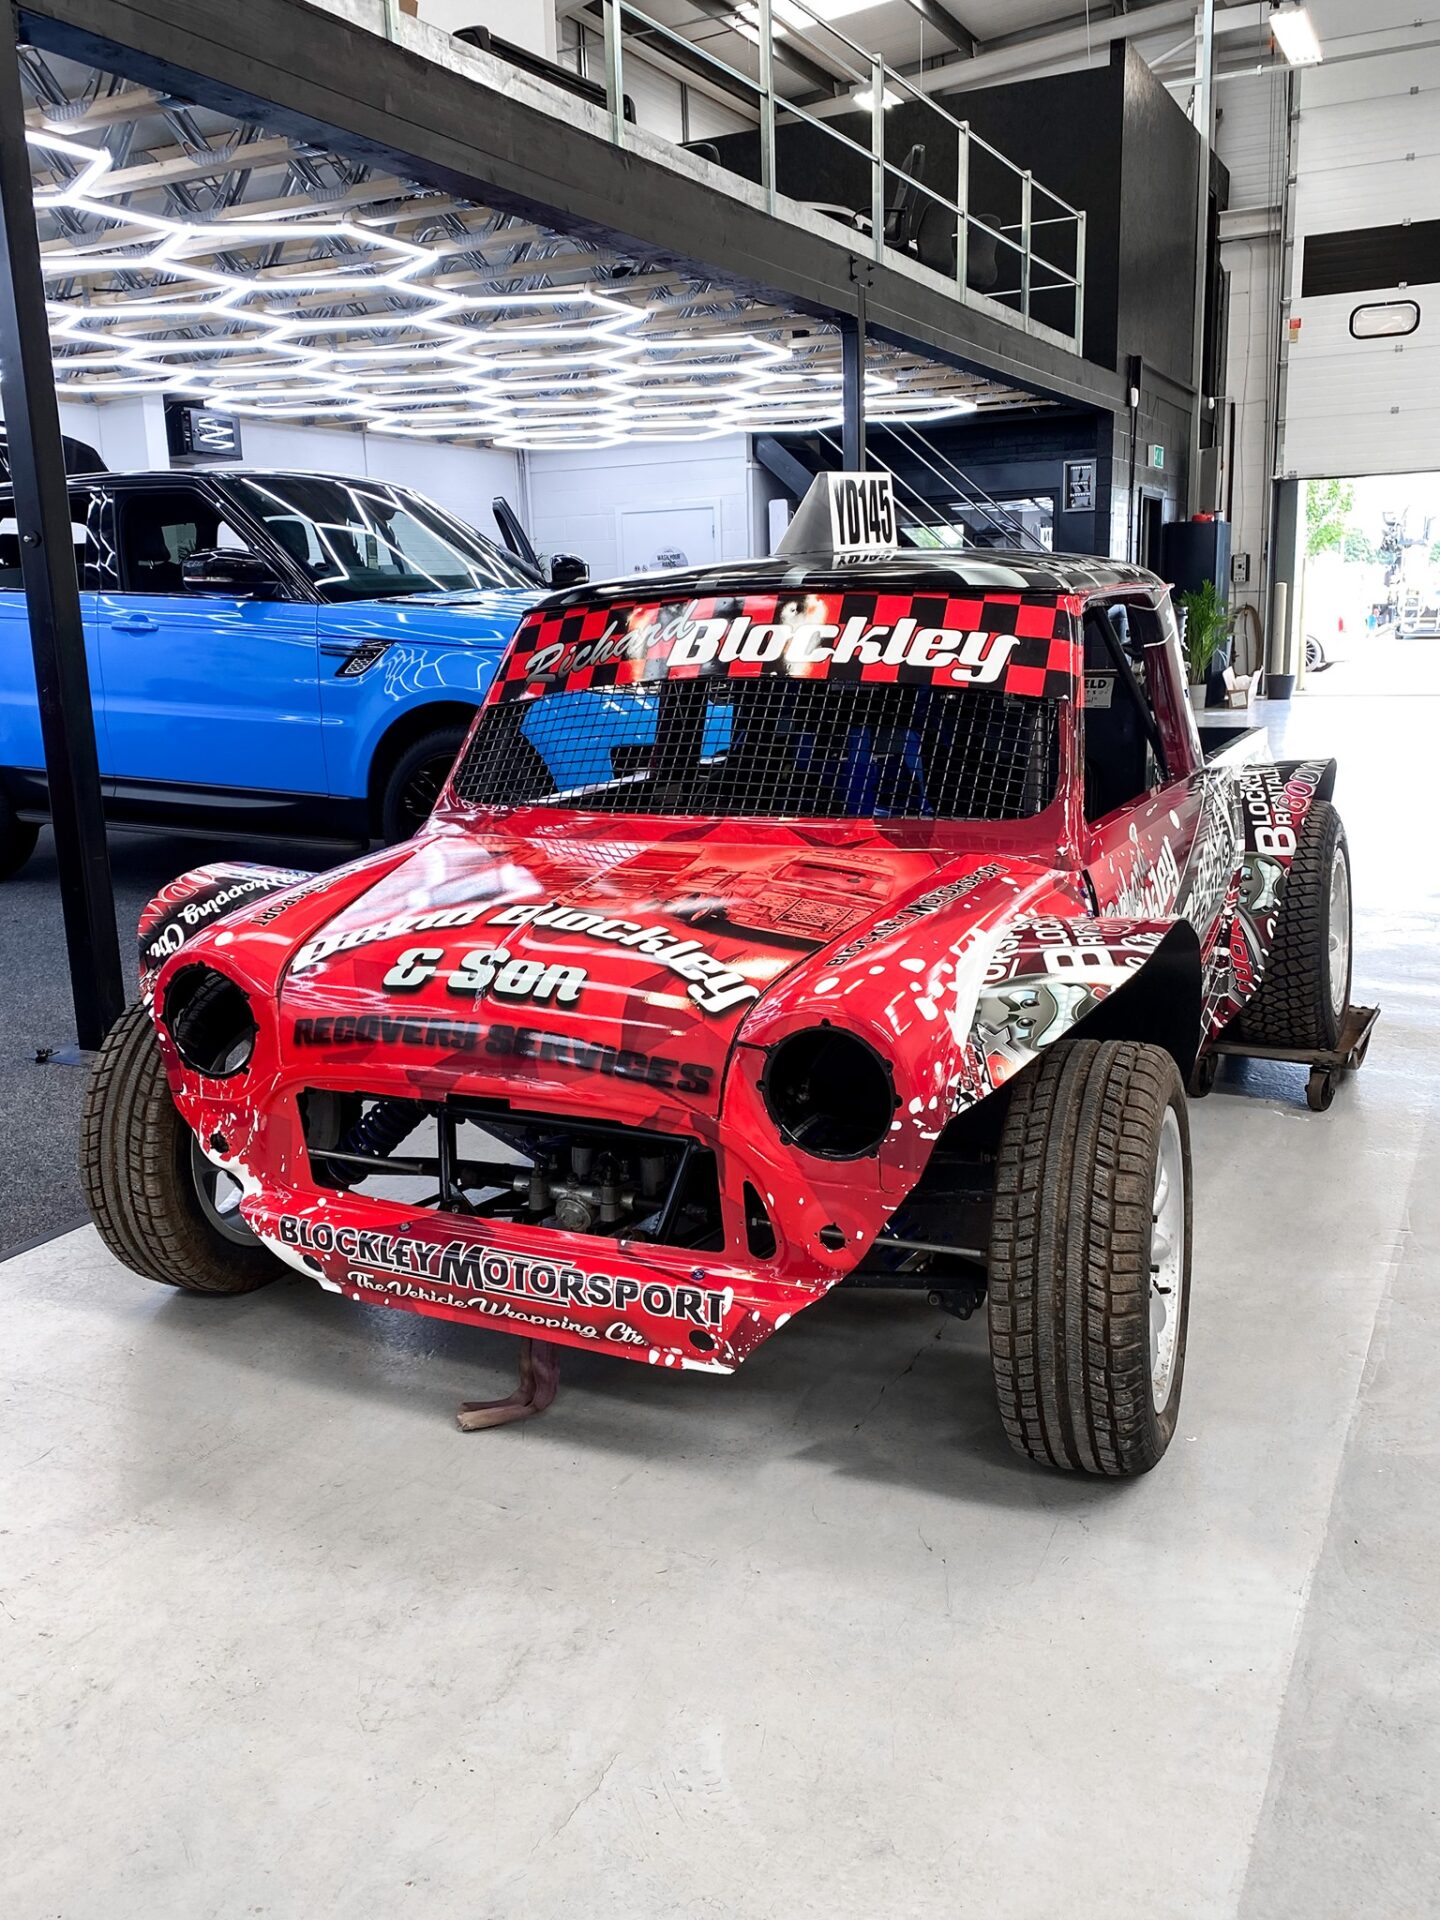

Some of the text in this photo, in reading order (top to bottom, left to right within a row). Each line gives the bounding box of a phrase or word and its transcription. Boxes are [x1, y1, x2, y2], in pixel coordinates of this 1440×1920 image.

[833, 479, 893, 545] YD145
[526, 599, 1021, 684] Richard Blockley
[823, 862, 1011, 968] BLOCKLEY MOTORSPORT
[383, 946, 588, 1005] & Son
[486, 903, 760, 1013] Blockley
[292, 1014, 715, 1095] RECOVERY SERVICES
[279, 1214, 729, 1327] BLOCKLEY MOTORSPORT
[348, 1271, 650, 1346] The Vehicle Wrapping Ctr.
